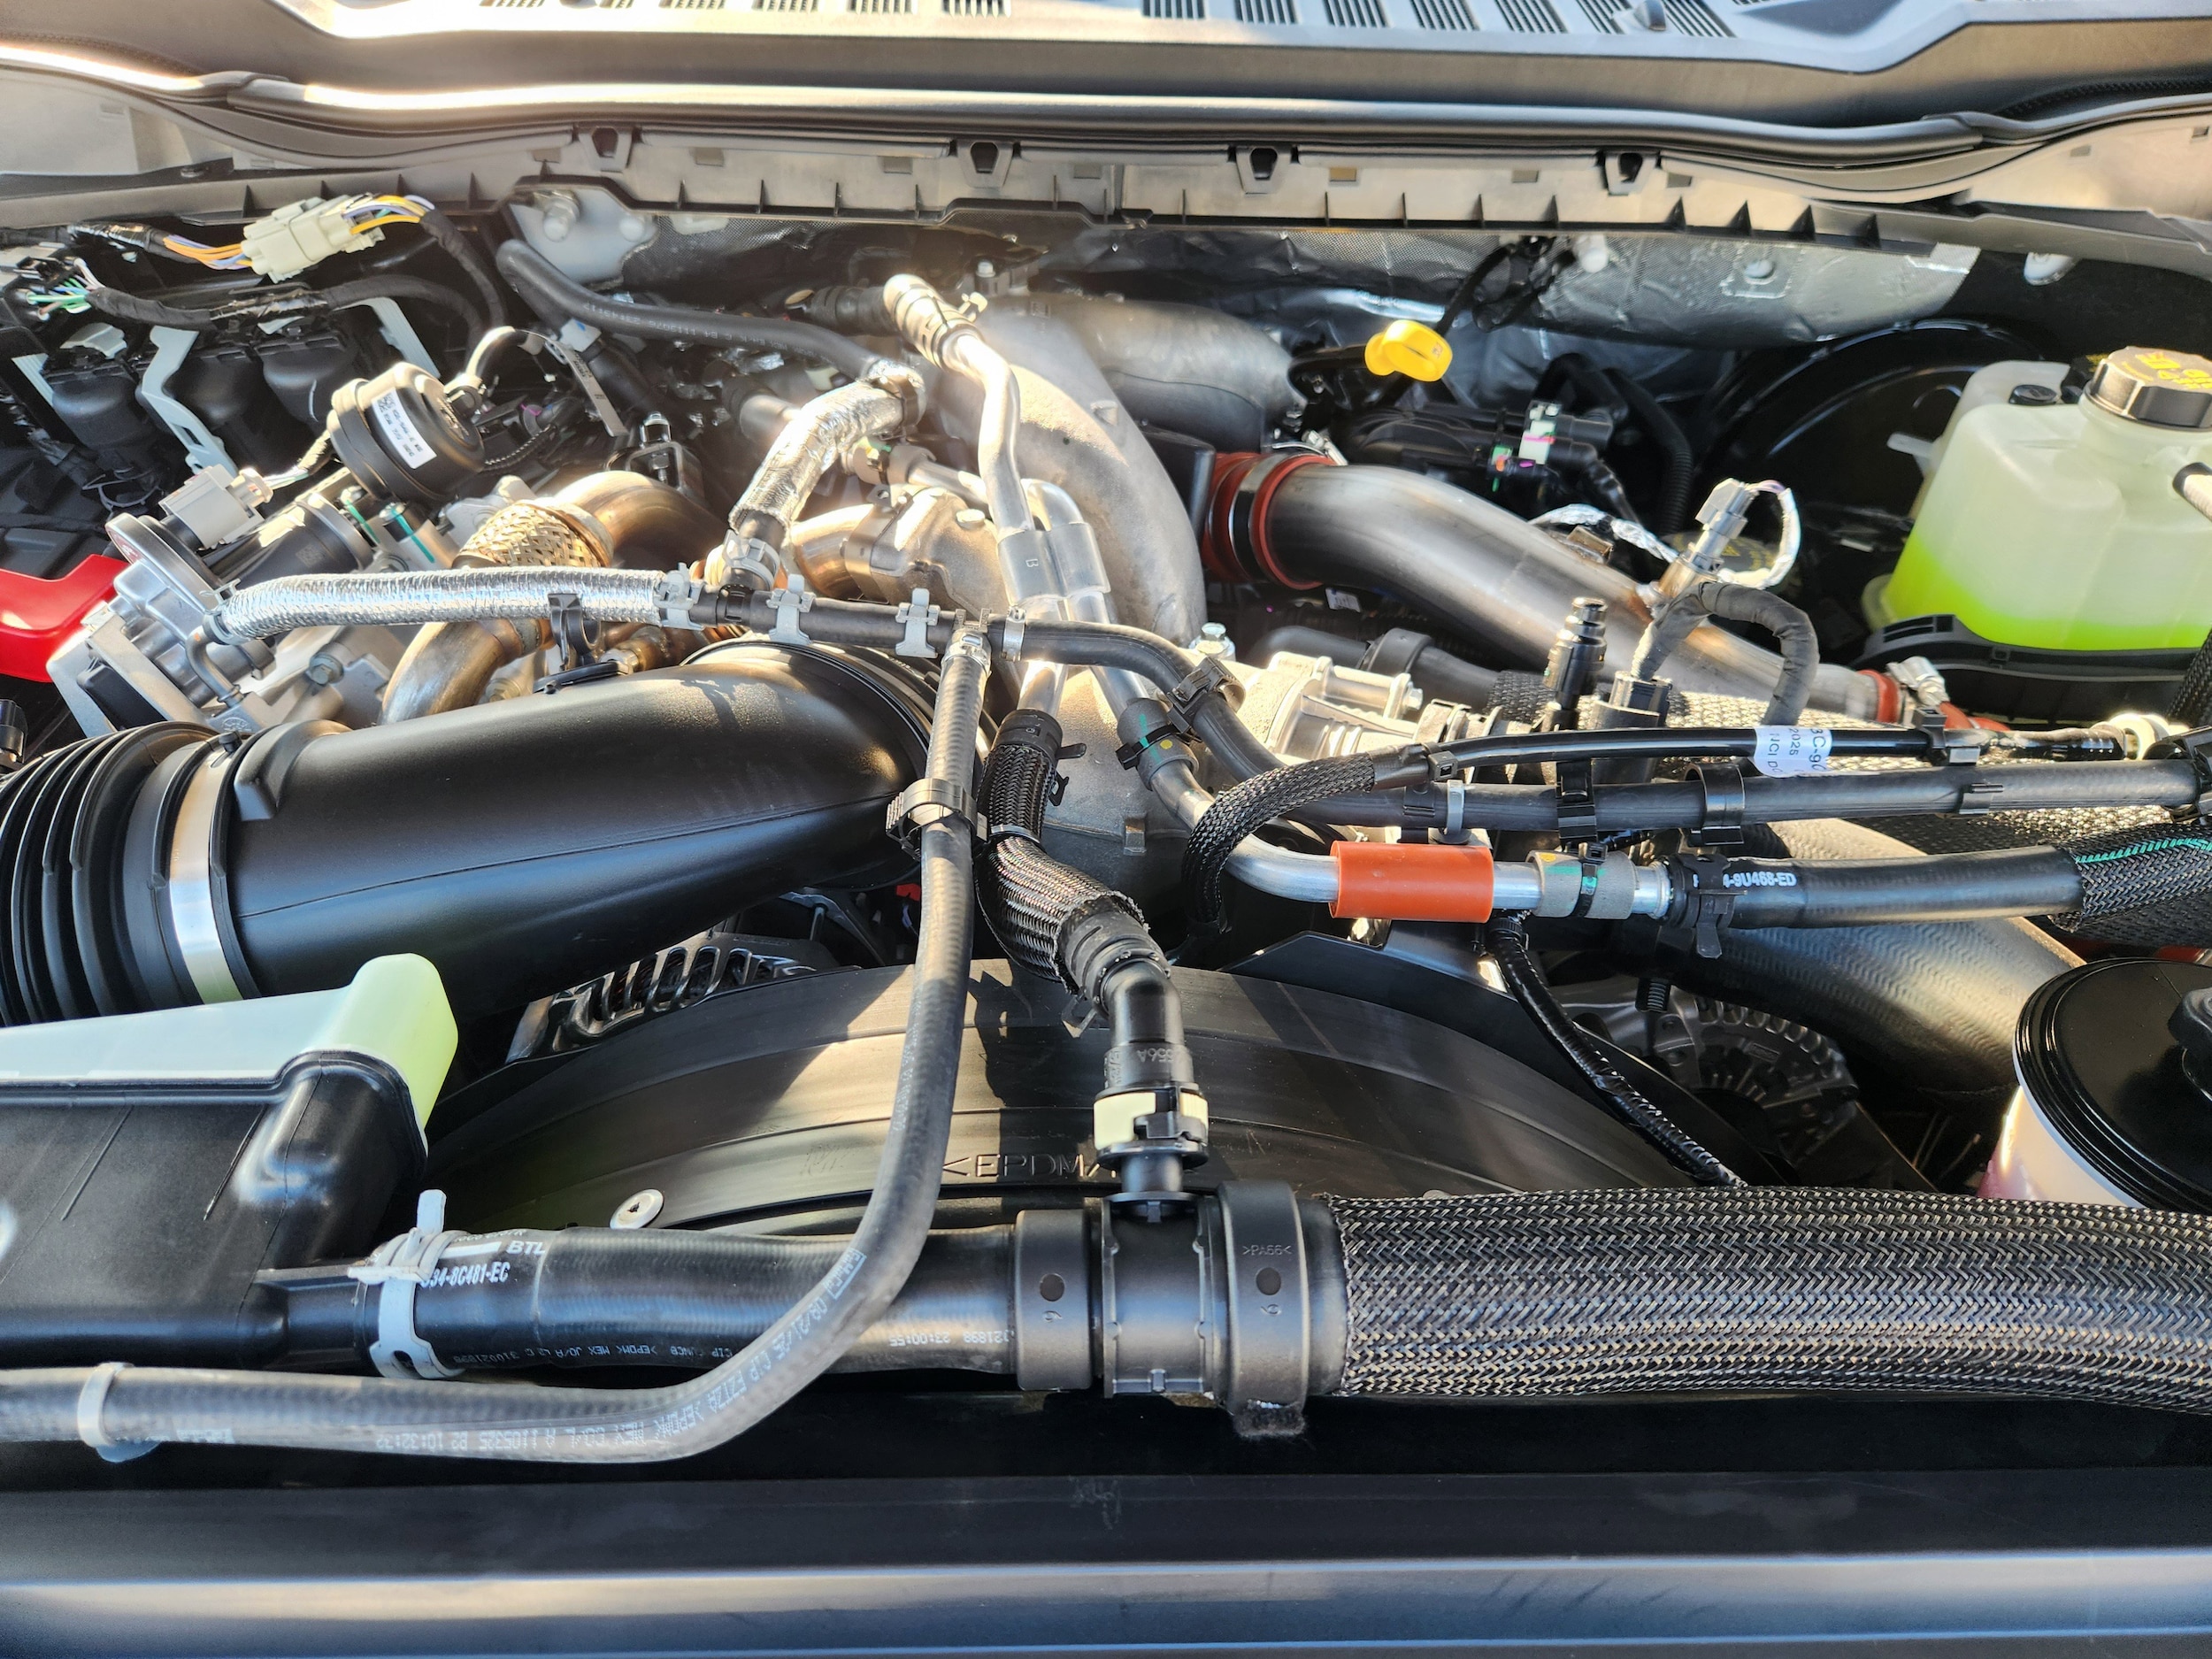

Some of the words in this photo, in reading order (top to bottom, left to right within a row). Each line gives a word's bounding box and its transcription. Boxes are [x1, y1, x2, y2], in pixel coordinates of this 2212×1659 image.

[506, 1240, 546, 1255] BTL
[588, 1344, 610, 1356] MEX
[616, 1343, 657, 1356] >EPDM<
